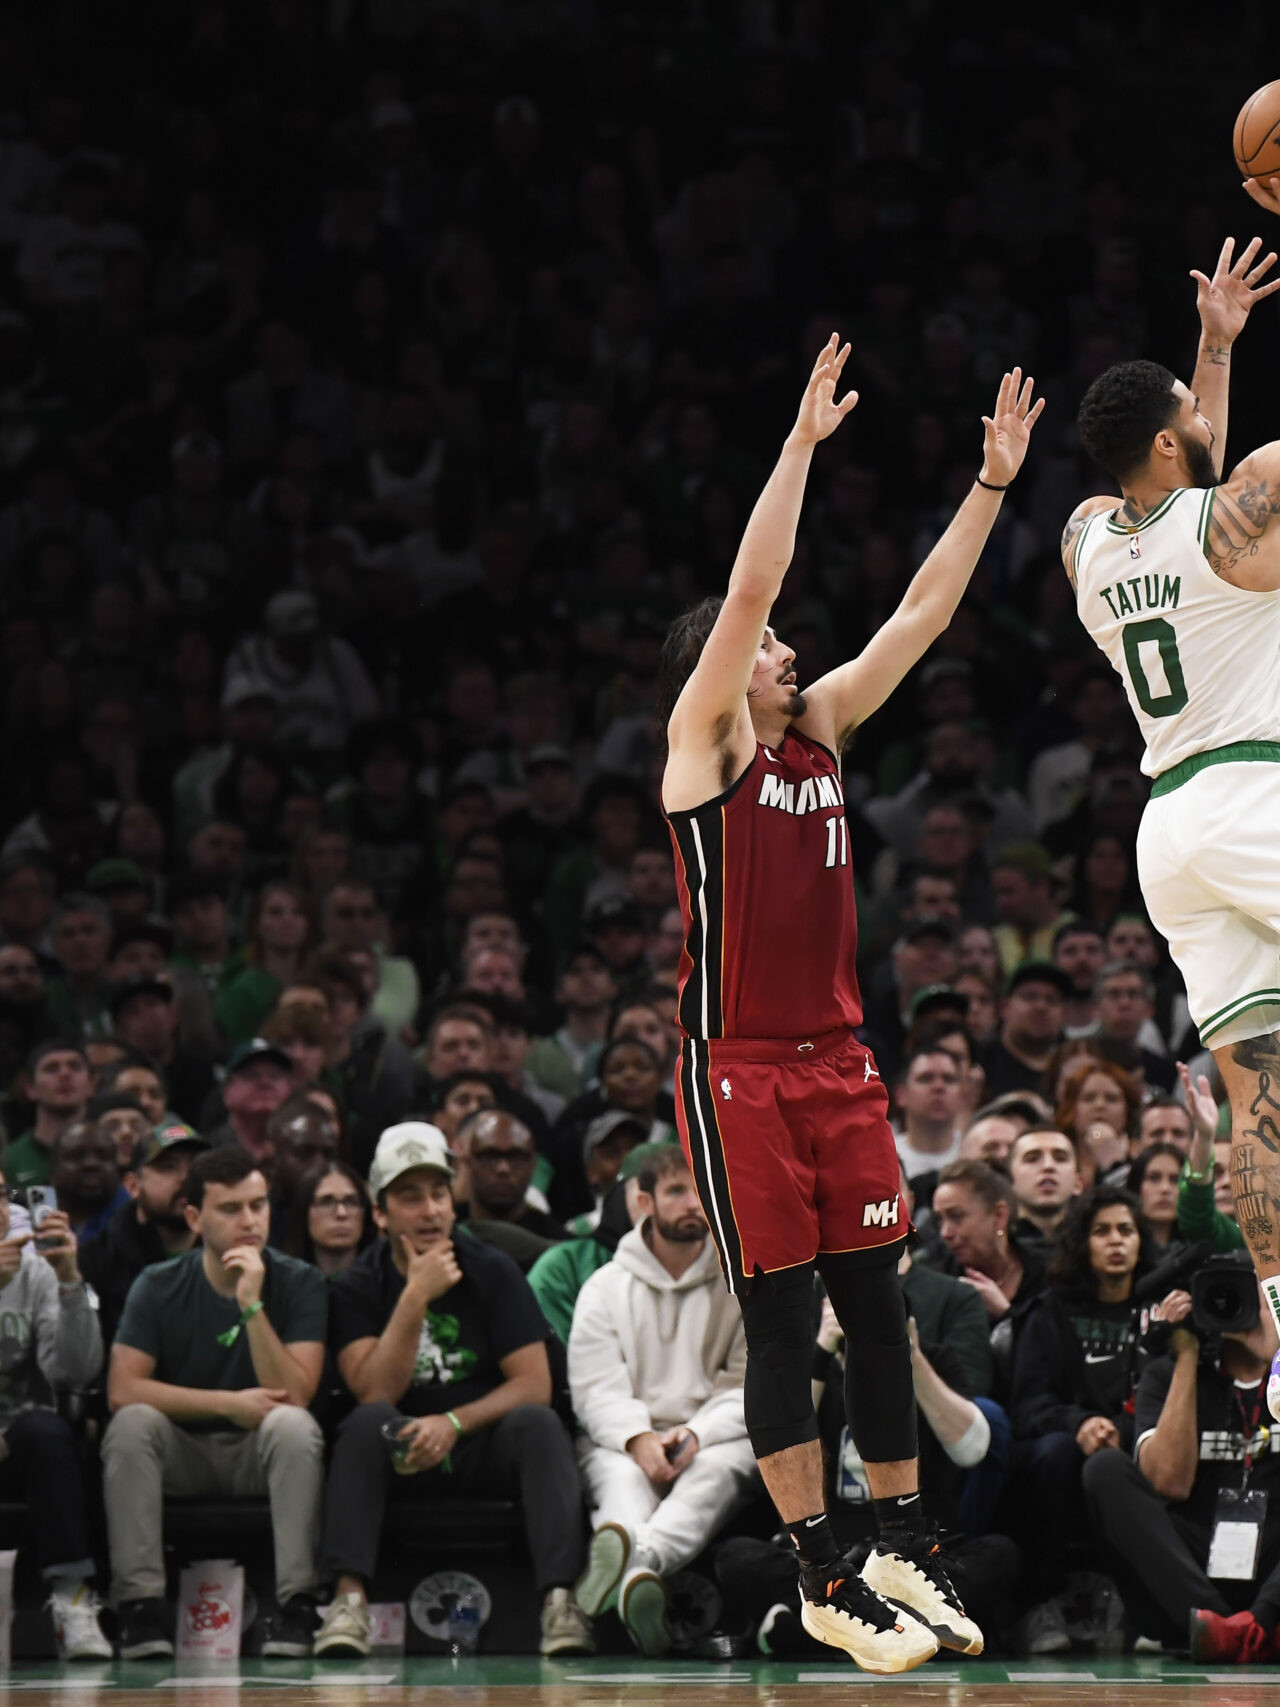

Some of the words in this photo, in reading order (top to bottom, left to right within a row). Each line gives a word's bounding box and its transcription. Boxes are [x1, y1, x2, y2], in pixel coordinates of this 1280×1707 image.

[1100, 574, 1181, 619] TATUM
[1122, 617, 1189, 719] 0
[758, 773, 845, 815] MIAMI
[825, 816, 847, 868] 11
